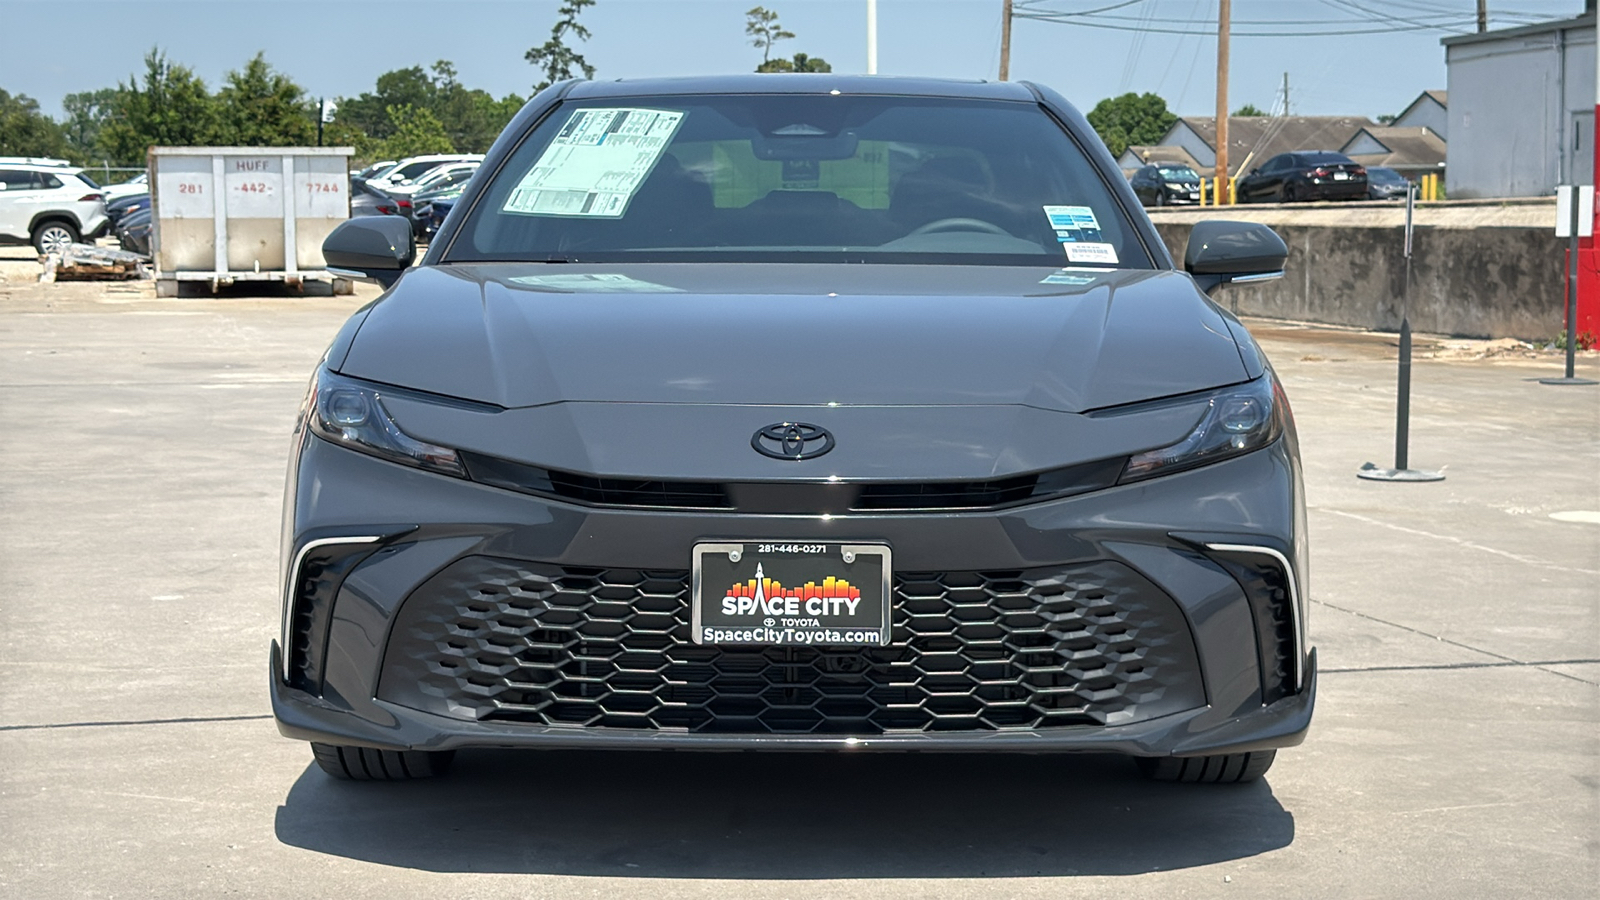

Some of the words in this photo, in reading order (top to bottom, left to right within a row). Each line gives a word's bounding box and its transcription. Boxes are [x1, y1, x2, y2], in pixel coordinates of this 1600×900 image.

[236, 161, 270, 171] HUFF
[180, 184, 203, 194] 281
[307, 183, 338, 193] 7744
[758, 545, 826, 553] 281-446-0271
[721, 597, 800, 615] SPACE
[805, 597, 861, 616] CITY
[781, 618, 820, 627] TOYOTA
[704, 628, 880, 644] SpaceCityToyota.com
